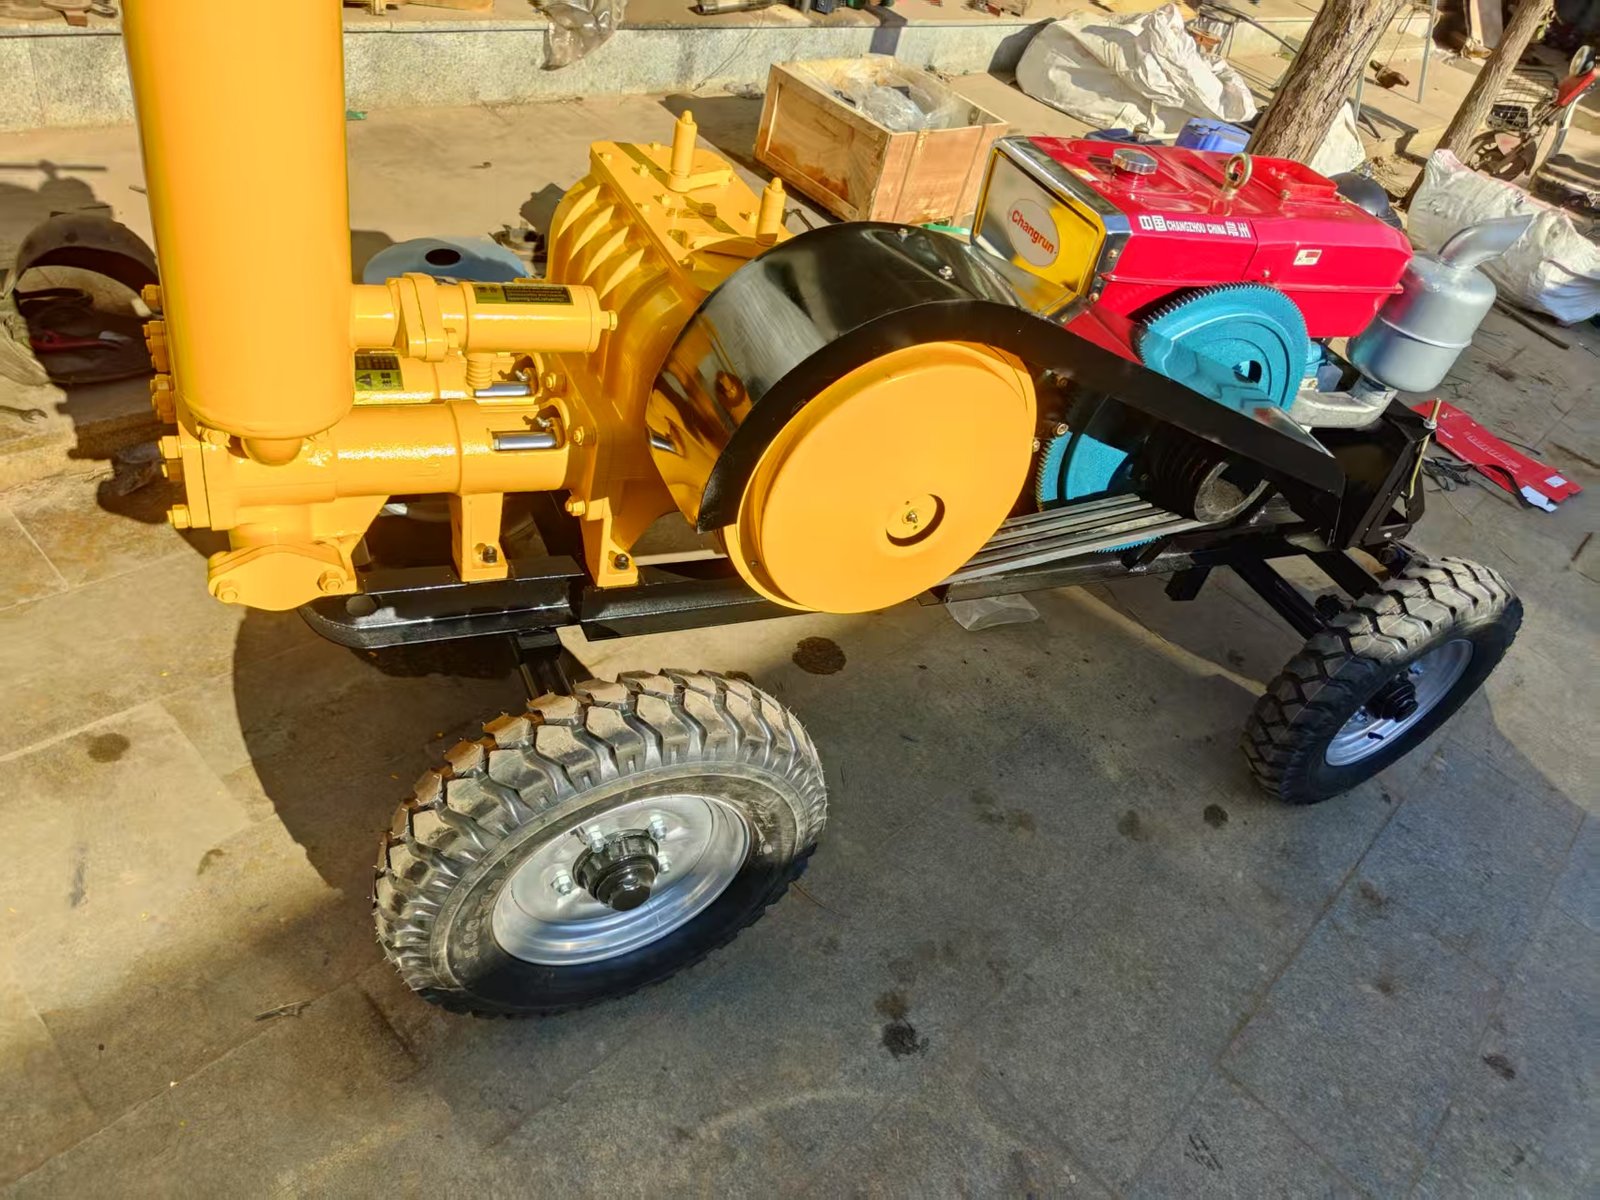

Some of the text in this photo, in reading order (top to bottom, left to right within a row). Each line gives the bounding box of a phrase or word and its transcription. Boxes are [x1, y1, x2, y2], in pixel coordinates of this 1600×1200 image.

[1011, 209, 1055, 254] Changrun
[1138, 215, 1168, 232] 中国
[1166, 220, 1207, 234] CHANGZHOU
[1206, 223, 1228, 235] CHINA
